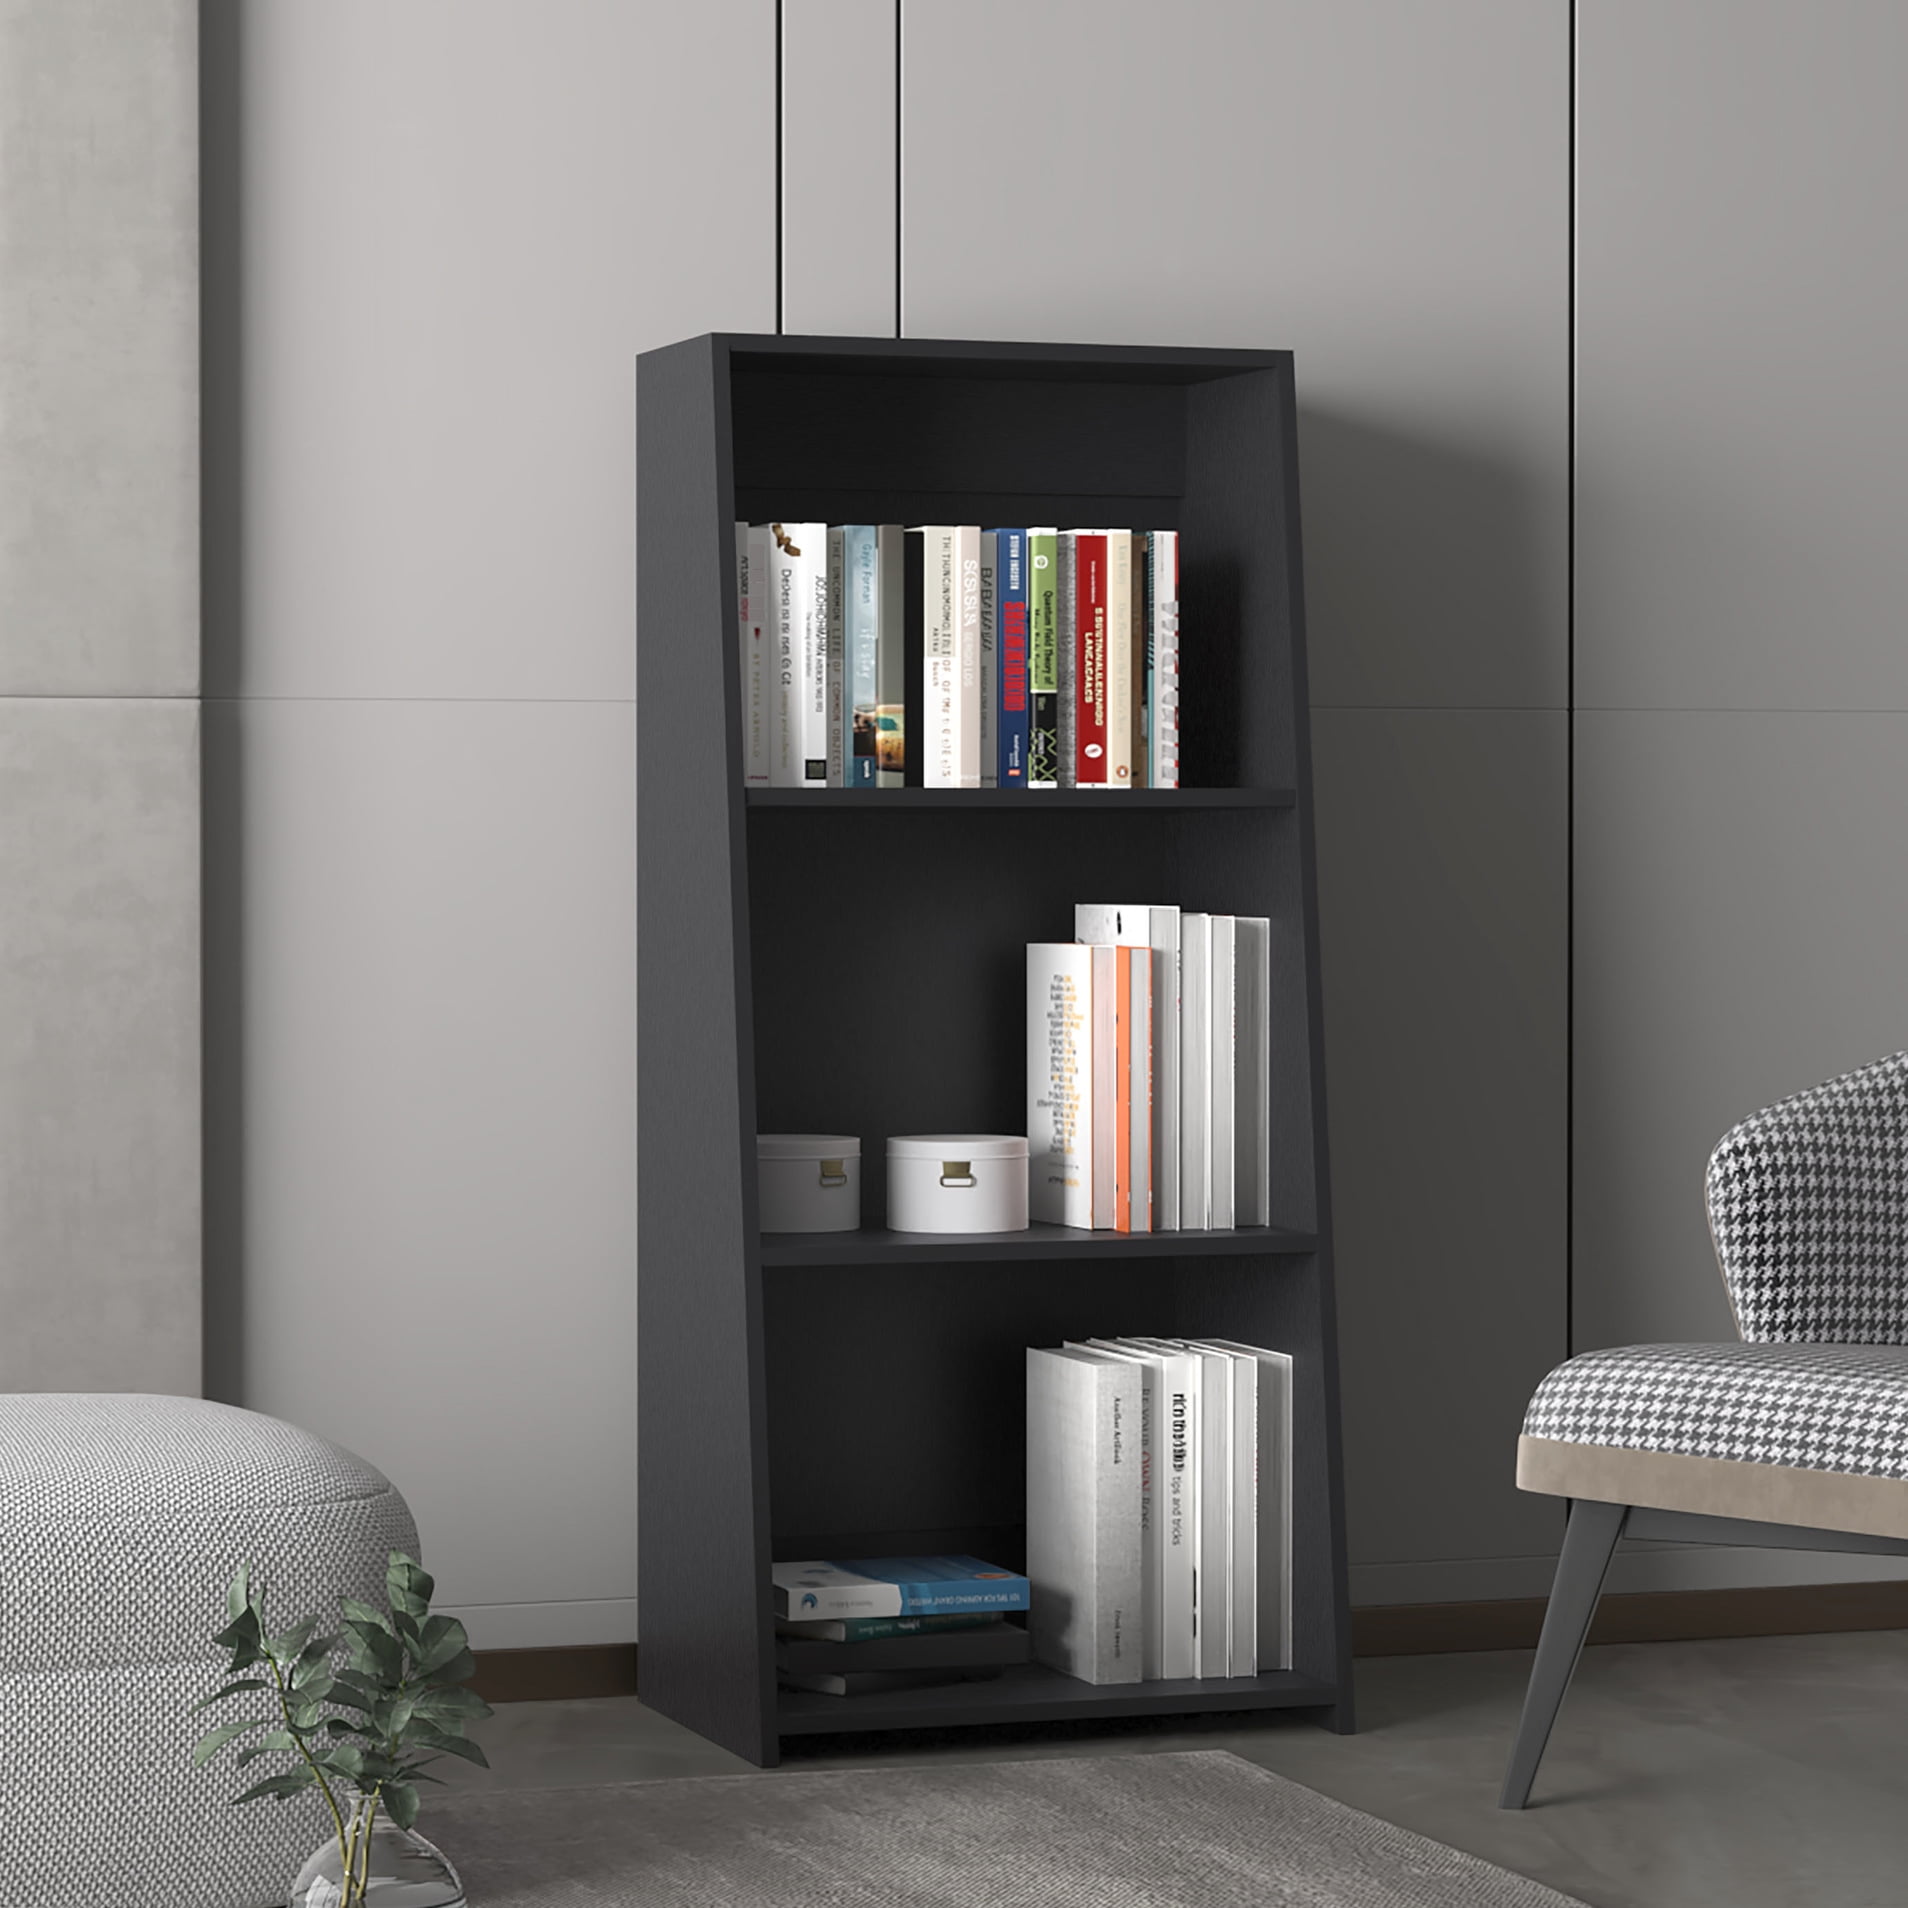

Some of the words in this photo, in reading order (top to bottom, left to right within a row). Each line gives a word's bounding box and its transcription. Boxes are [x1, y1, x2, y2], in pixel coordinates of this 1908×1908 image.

[861, 543, 873, 568] Gayle
[832, 566, 841, 621] UNCOMMON
[861, 571, 872, 604] Forman
[1043, 590, 1054, 626] Quantum
[832, 628, 841, 654] LIFE
[1044, 628, 1055, 647] Field
[1041, 648, 1054, 674] Theory
[1044, 675, 1054, 685] of
[832, 681, 841, 722] COMMON
[832, 728, 841, 776] OBJECTS
[1113, 1396, 1122, 1429] Another
[1142, 1451, 1151, 1491] OWN
[1171, 1476, 1182, 1495] tips
[1173, 1497, 1182, 1516] and
[1172, 1518, 1182, 1546] tricks
